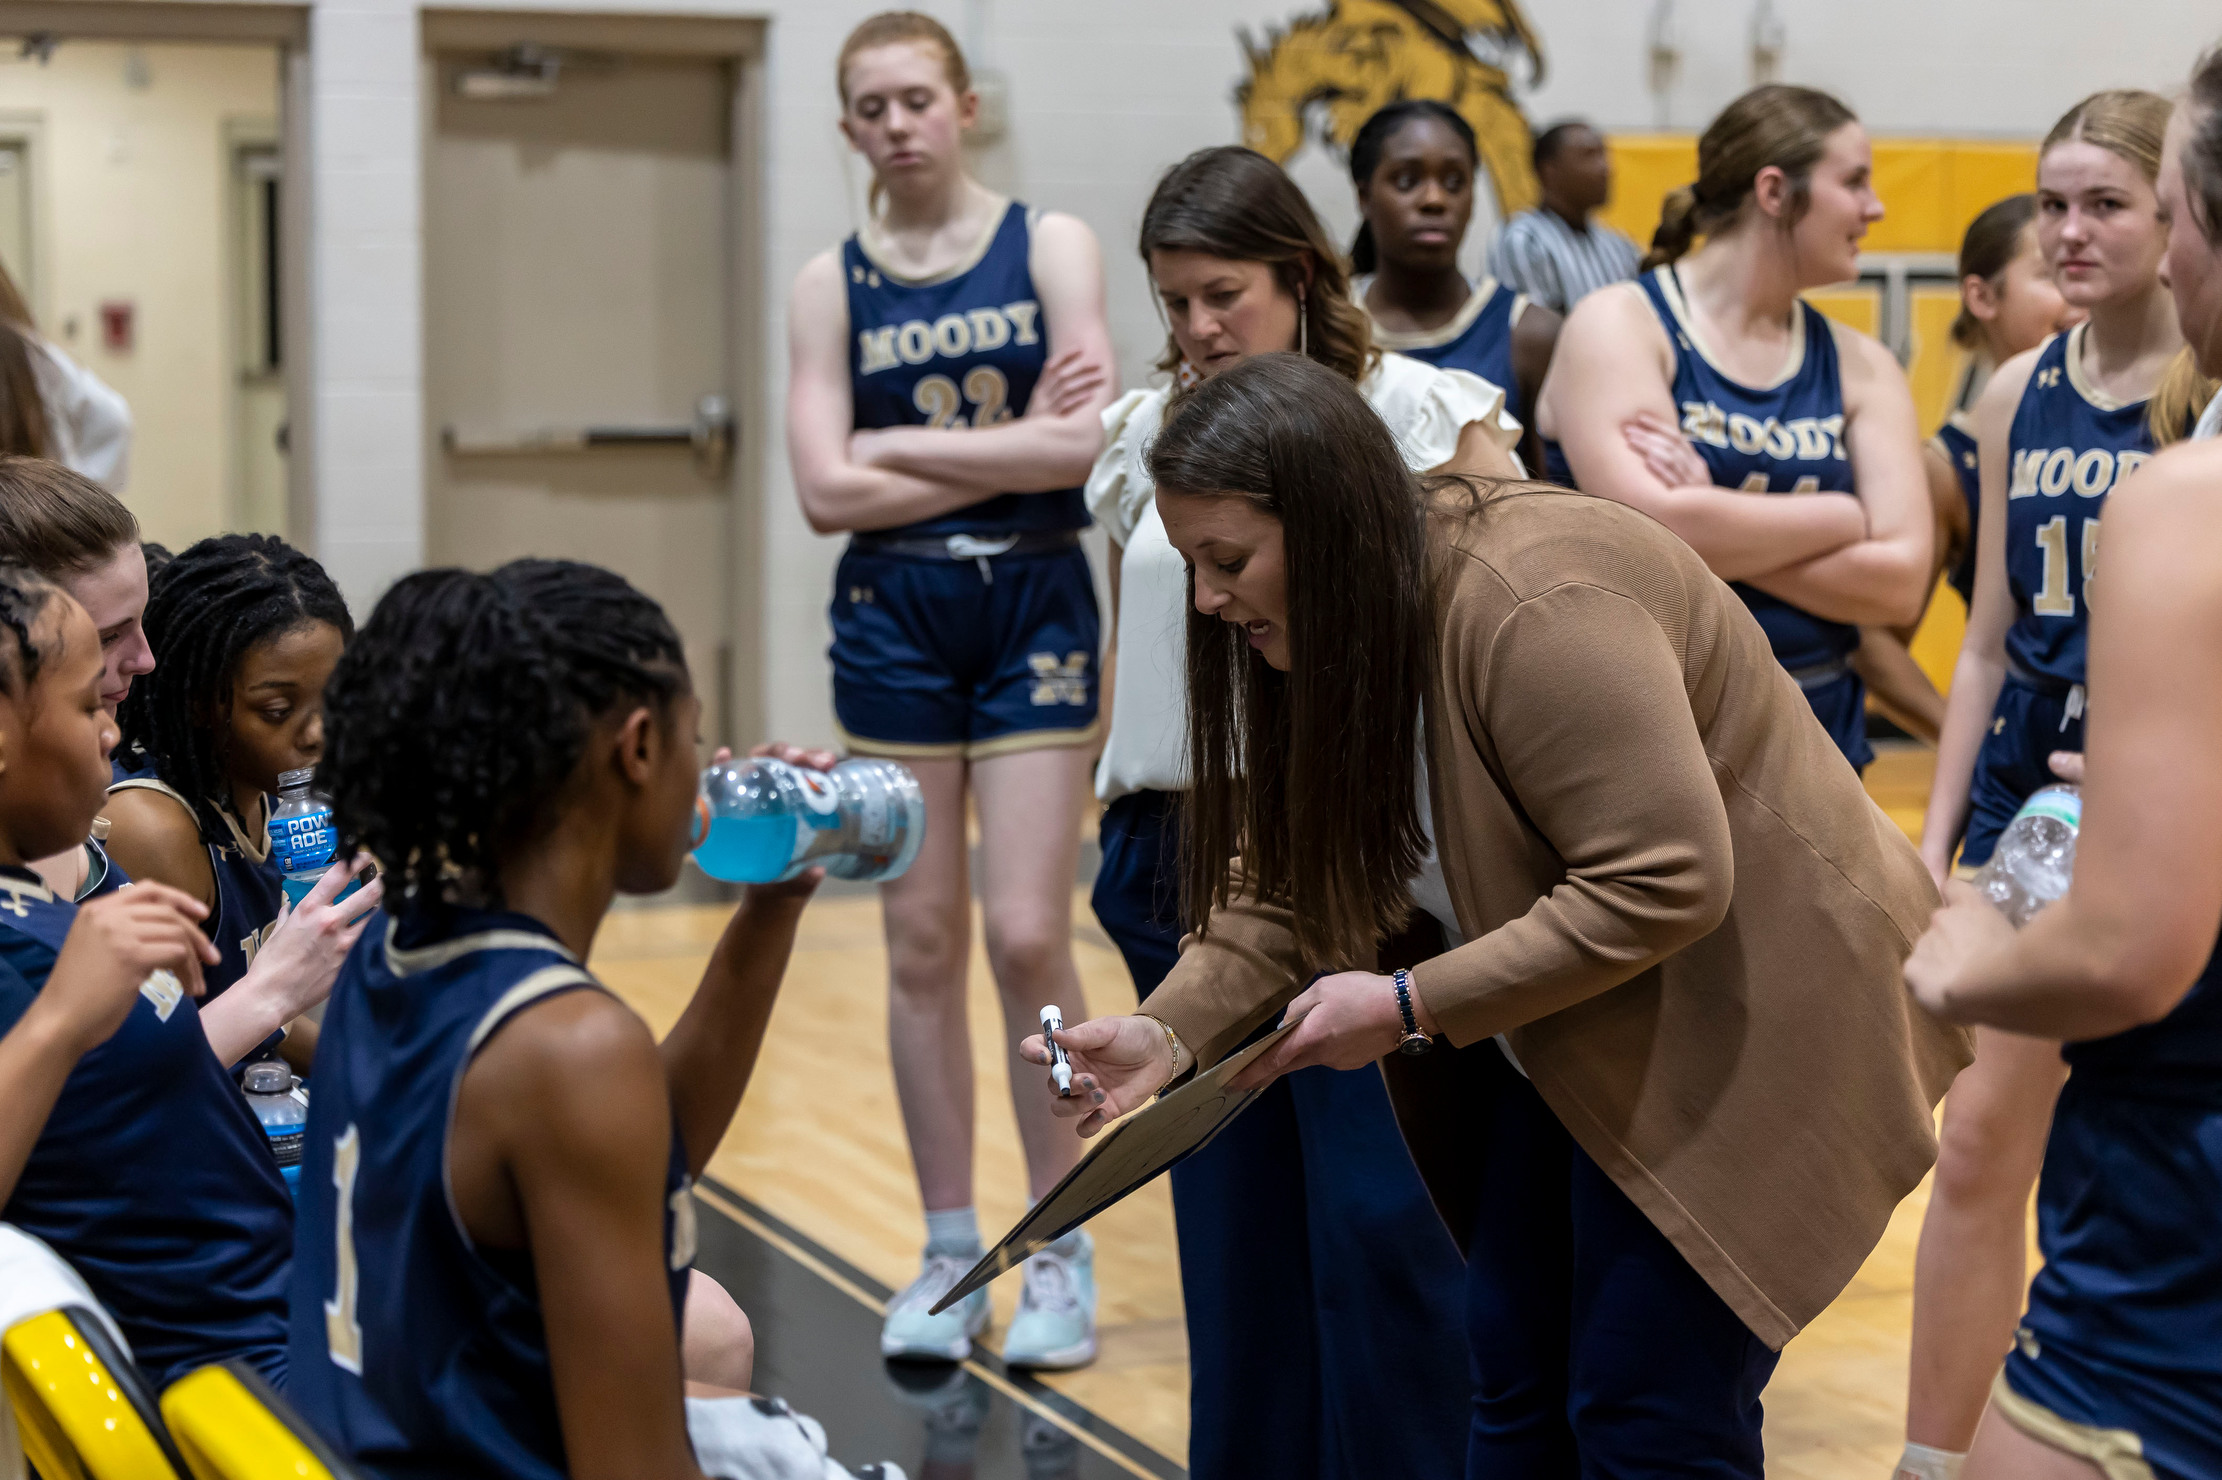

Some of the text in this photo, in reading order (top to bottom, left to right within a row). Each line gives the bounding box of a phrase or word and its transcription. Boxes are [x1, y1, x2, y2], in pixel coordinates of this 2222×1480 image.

[858, 301, 1040, 376] MOODY
[912, 364, 1014, 430] 22
[291, 829, 328, 850] ADE
[324, 1123, 363, 1377] 1
